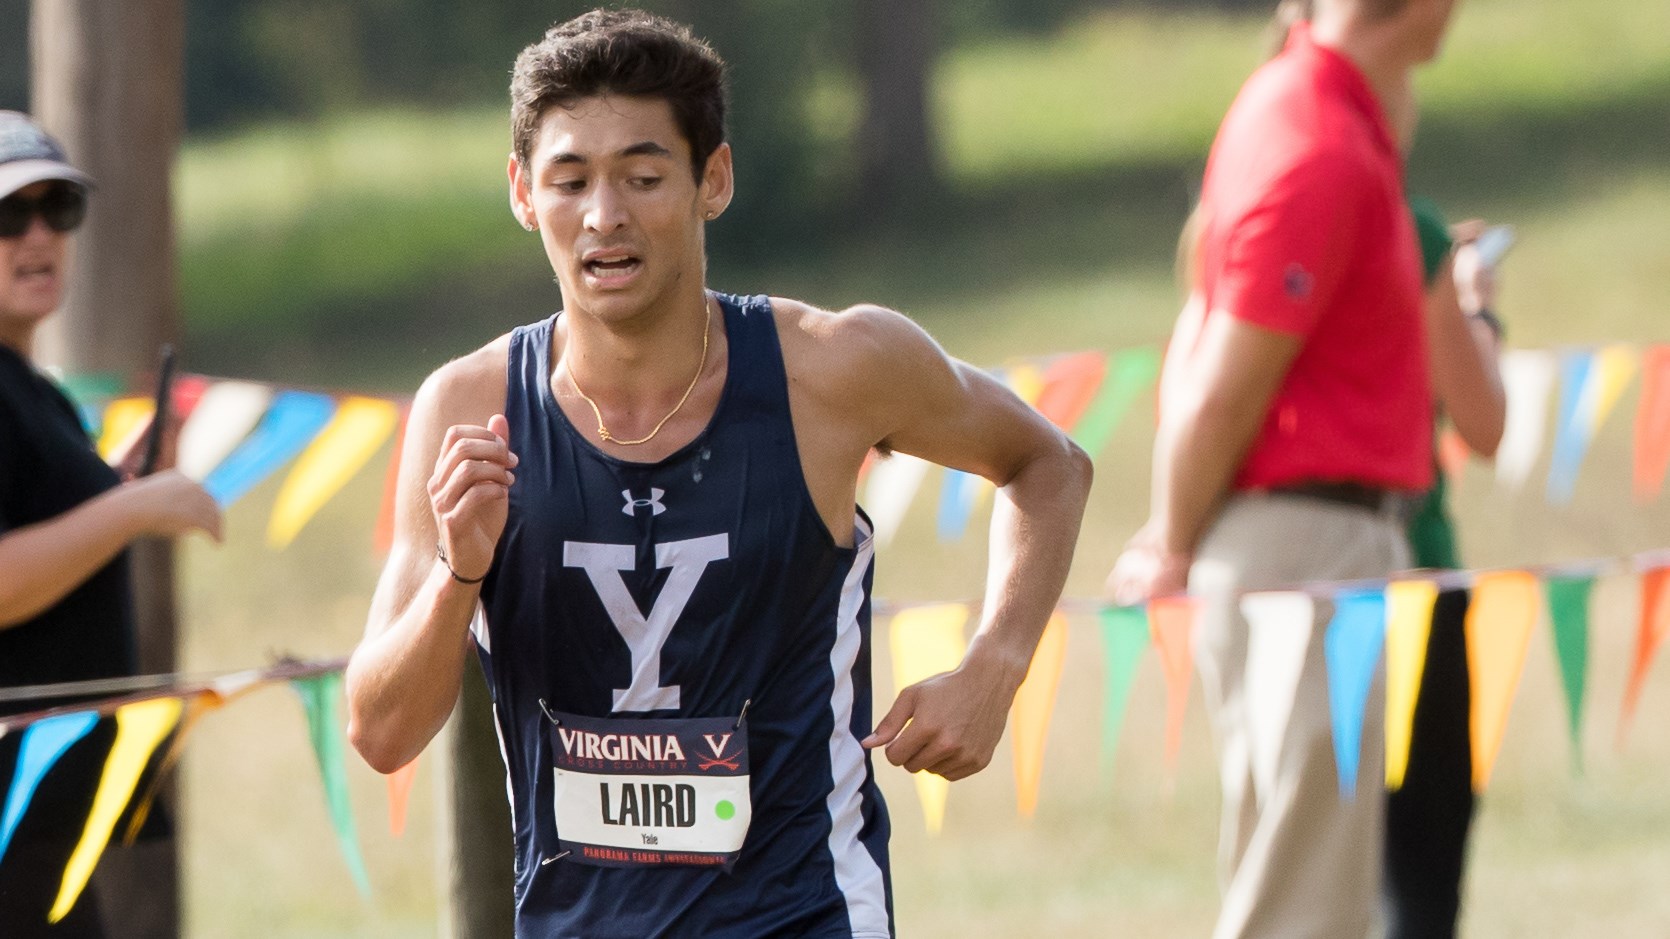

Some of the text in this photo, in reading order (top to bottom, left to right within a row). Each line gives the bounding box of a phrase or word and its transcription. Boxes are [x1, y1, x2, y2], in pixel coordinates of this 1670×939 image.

[563, 532, 729, 712] Y
[558, 728, 687, 761] VIRGINIA
[702, 734, 733, 759] V
[600, 783, 696, 828] LAIRD
[641, 833, 659, 845] Yale
[584, 847, 629, 861] PANORAMA
[632, 852, 662, 864] FARMS
